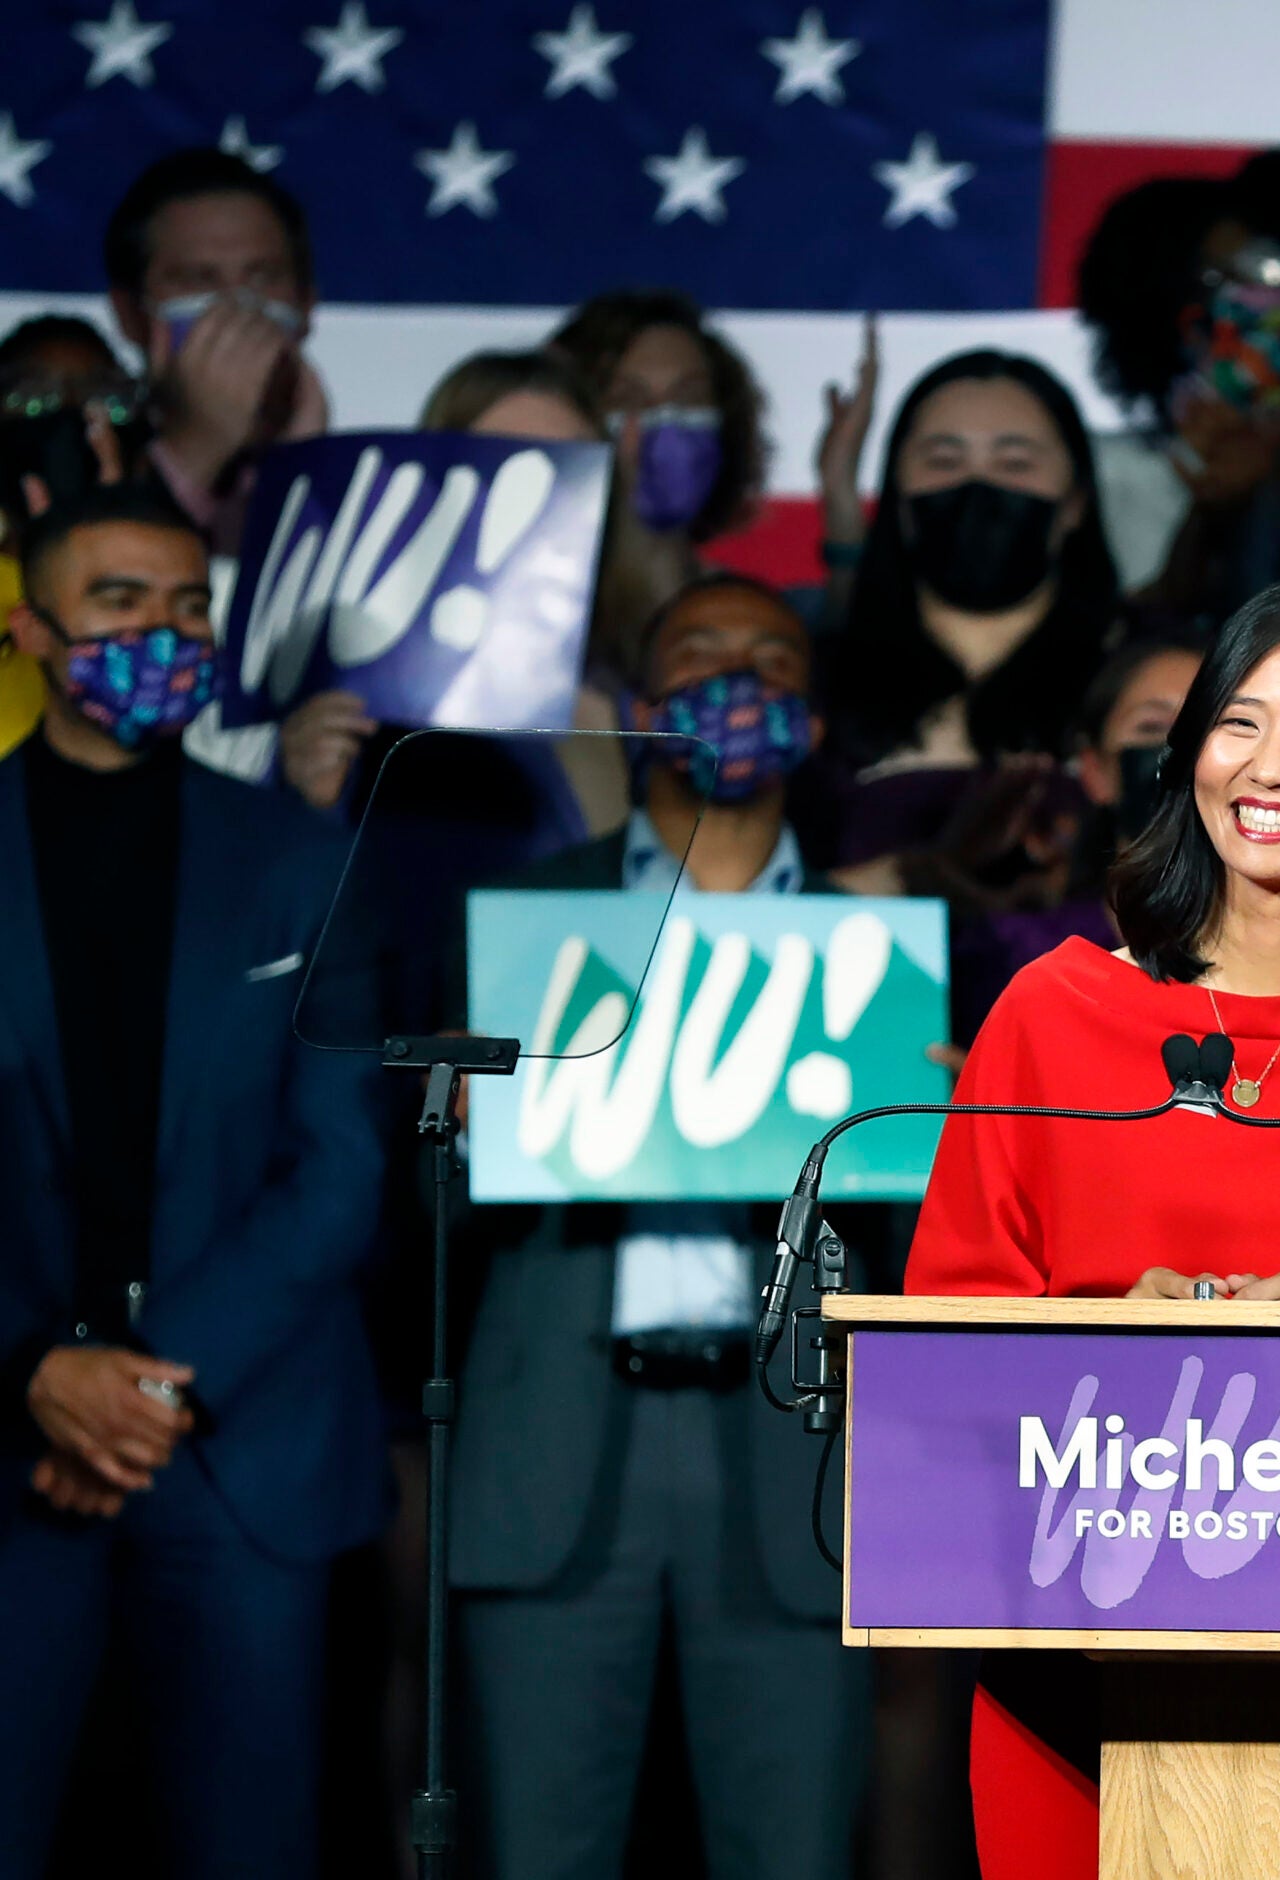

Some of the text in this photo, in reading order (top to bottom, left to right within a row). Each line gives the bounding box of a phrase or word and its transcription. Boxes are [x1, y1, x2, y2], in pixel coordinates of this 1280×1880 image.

[240, 445, 556, 703] WU!
[518, 913, 893, 1178] WU!
[1074, 1508, 1153, 1539] FOR
